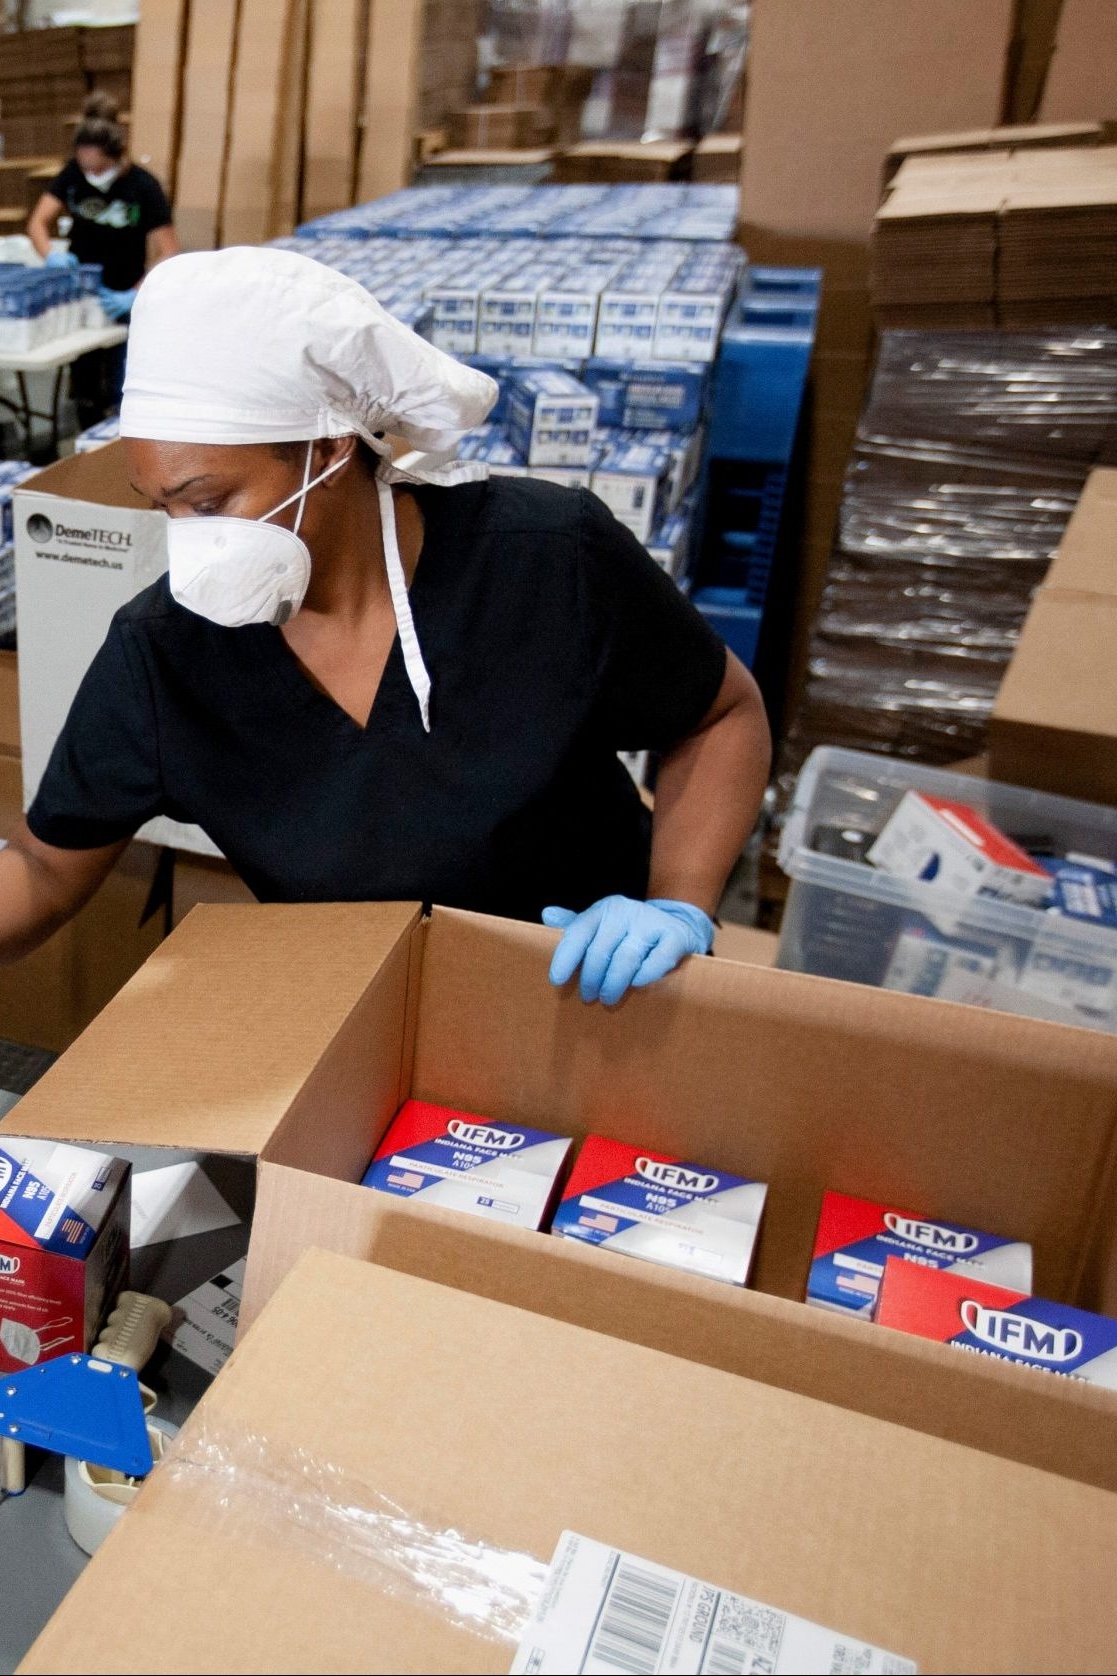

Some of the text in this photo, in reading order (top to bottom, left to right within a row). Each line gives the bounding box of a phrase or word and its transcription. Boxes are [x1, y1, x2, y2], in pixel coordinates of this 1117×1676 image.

[55, 524, 132, 546] DemeTECH
[35, 551, 124, 570] www.demetech.us
[463, 1127, 505, 1145] IFM
[435, 1138, 473, 1151] INDIANA
[474, 1145, 497, 1157] FACE
[452, 1151, 482, 1164] N95
[652, 1166, 699, 1188] IFM
[22, 1180, 41, 1199] N95
[624, 1178, 665, 1193] INDIANA
[667, 1187, 692, 1200] FACE
[645, 1192, 677, 1208] N95
[905, 1223, 956, 1248] IFM
[876, 1234, 923, 1253] INDIANA
[926, 1247, 954, 1261] FACE
[904, 1253, 940, 1269] N95
[987, 1316, 1055, 1355] IFM
